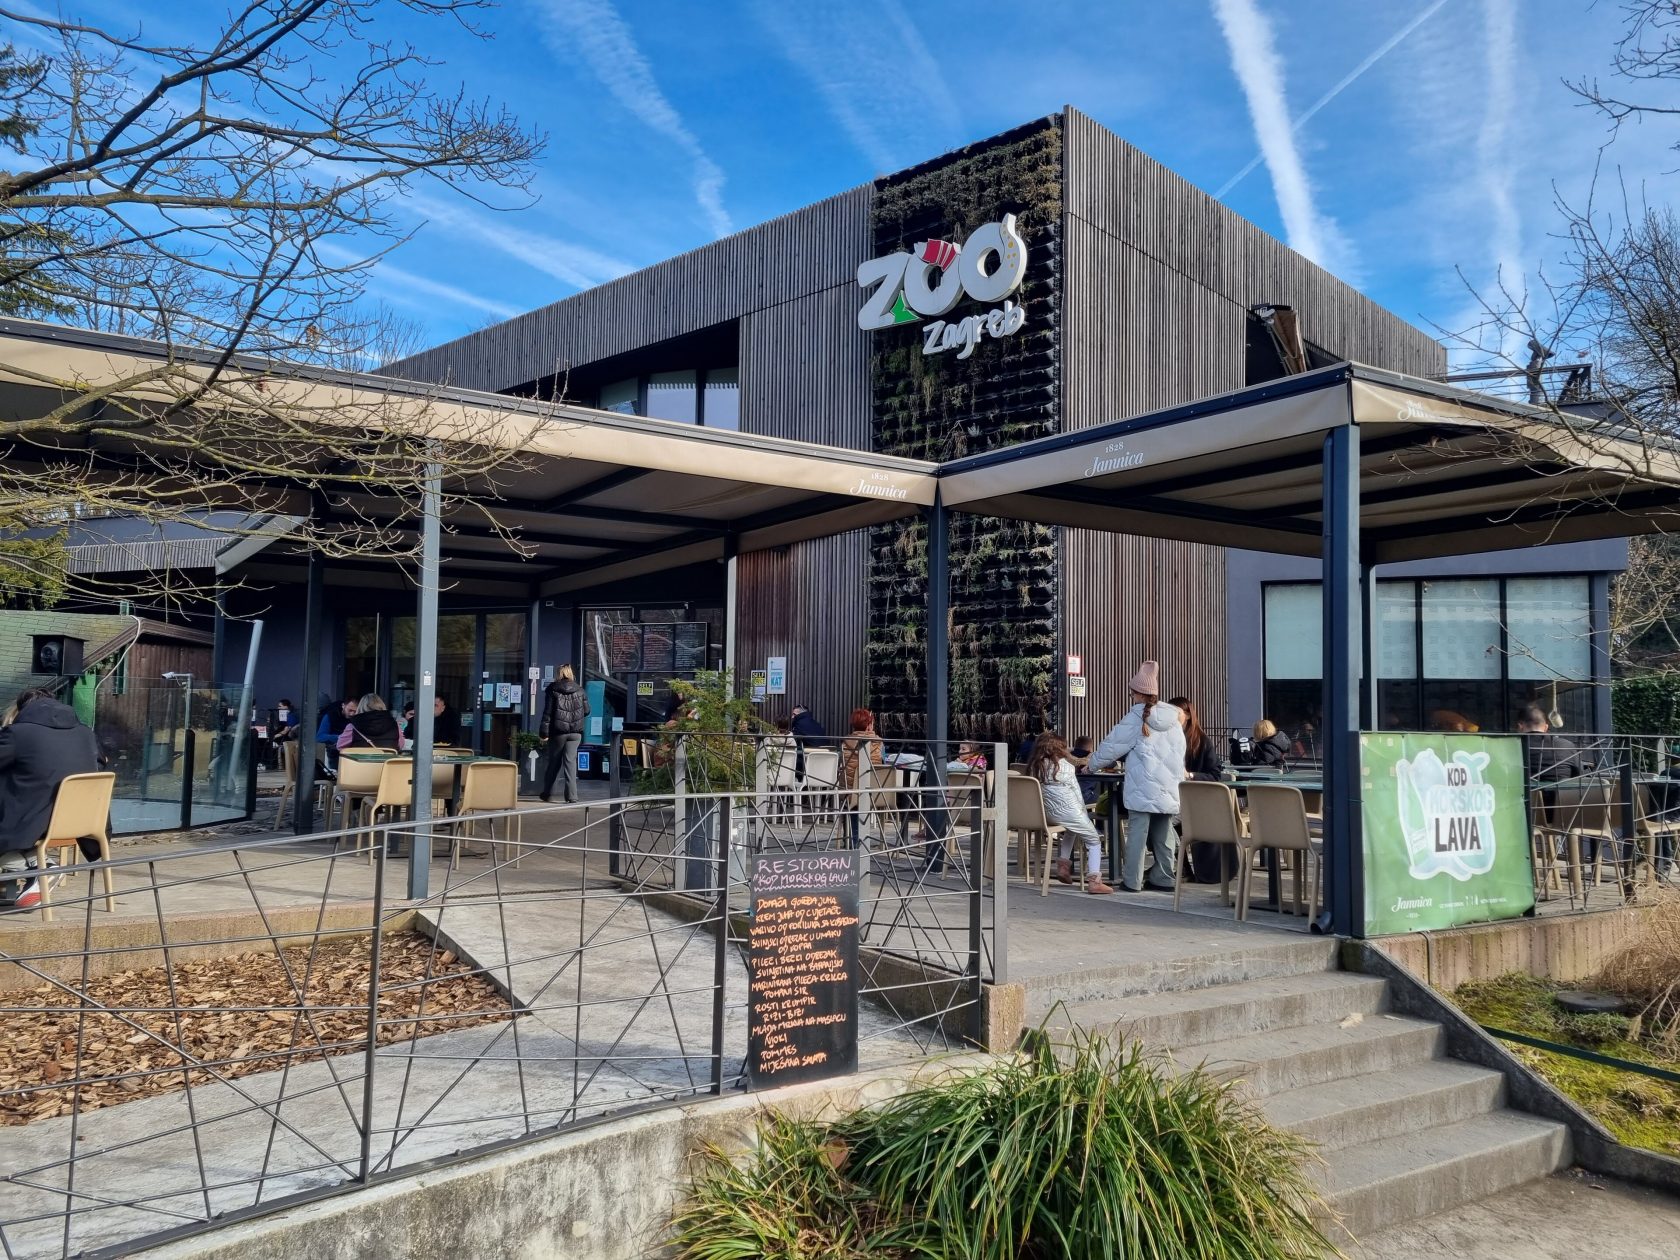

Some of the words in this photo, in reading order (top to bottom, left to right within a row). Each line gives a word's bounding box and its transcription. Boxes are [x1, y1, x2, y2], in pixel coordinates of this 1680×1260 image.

[857, 213, 1027, 330] ZOO
[923, 300, 1025, 359] Zagreb
[1105, 441, 1124, 453] 1828
[1084, 451, 1144, 477] Jamnica
[850, 478, 907, 499] Jamnica
[1448, 768, 1467, 786] KOD
[1431, 788, 1493, 814] MORSKOG
[1435, 816, 1481, 852] LAVA
[757, 856, 852, 873] RESTORAN
[781, 872, 827, 887] MORSKOG
[1391, 896, 1432, 912] Jamnica
[809, 932, 814, 940] U
[794, 986, 808, 996] SIR
[760, 1044, 797, 1060] POMMES
